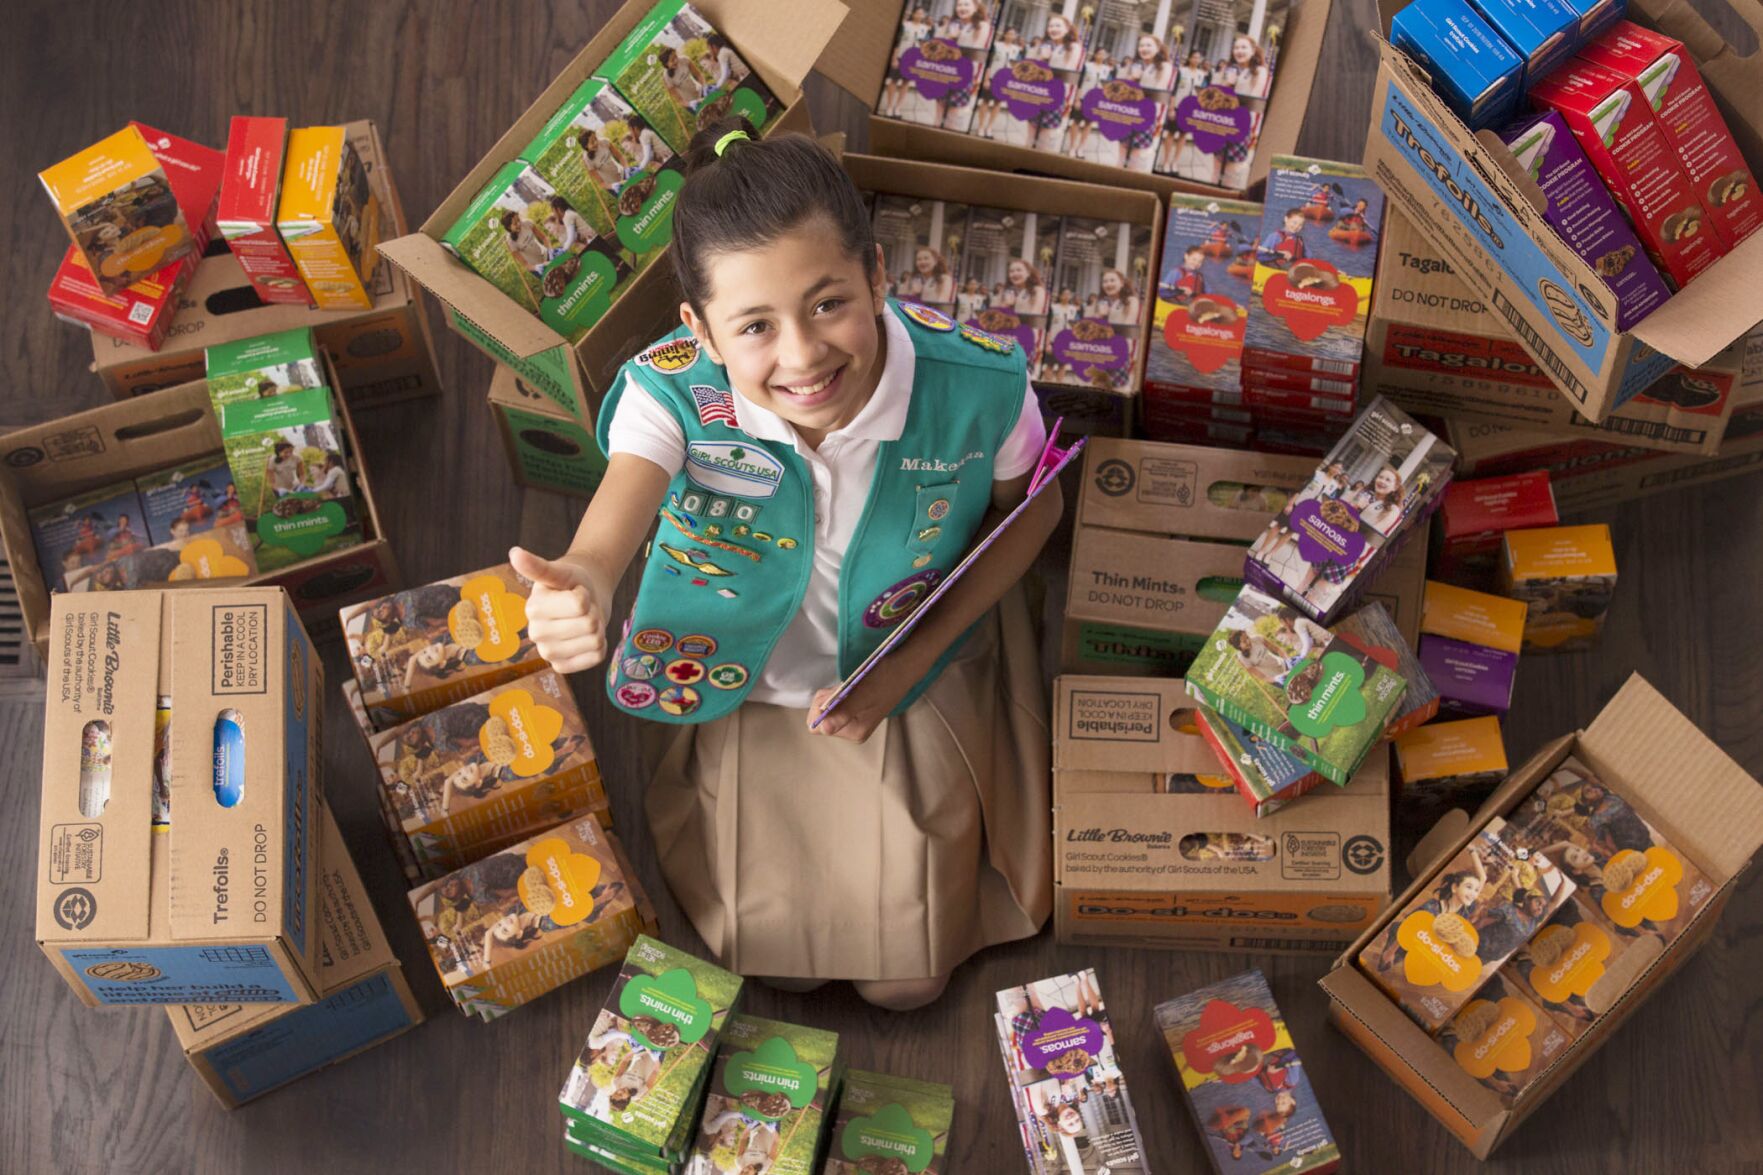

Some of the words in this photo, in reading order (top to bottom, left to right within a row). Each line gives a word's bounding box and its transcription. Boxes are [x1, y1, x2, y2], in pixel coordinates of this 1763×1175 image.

[1558, 157, 1583, 180] PROGRAM
[633, 213, 652, 236] thin
[557, 295, 577, 316] thin
[1392, 289, 1411, 302] DO
[1412, 291, 1448, 309] NOT
[691, 448, 710, 463] GIRL
[714, 457, 755, 473] SCOUTS
[757, 466, 778, 478] USA
[273, 520, 296, 533] thin
[1092, 571, 1129, 590] Thin
[1088, 590, 1109, 605] DO
[1111, 592, 1143, 609] NOT
[1144, 594, 1185, 612] DROP
[64, 613, 74, 628] Girl
[76, 613, 86, 637] baked
[88, 612, 98, 627] Girl
[237, 613, 246, 641] COOL
[87, 627, 98, 651] Scout
[105, 611, 121, 650] Little
[249, 611, 258, 665] LOCATION
[63, 629, 73, 657] Scouts
[74, 638, 84, 649] by
[221, 612, 234, 688] Perishable
[237, 642, 245, 650] A
[63, 658, 73, 667] of
[75, 650, 84, 664] the
[236, 651, 246, 661] IN
[63, 668, 72, 682] the
[73, 664, 83, 703] authority
[103, 651, 119, 715] Brownie
[236, 662, 246, 687] KEEP
[249, 666, 258, 687] DRY
[73, 704, 82, 713] of
[1077, 698, 1131, 710] LOCATION
[1133, 699, 1153, 710] DRY
[1308, 697, 1324, 720] thin
[1077, 709, 1107, 720] COOL
[1128, 710, 1153, 721] KEEP
[1077, 720, 1153, 734] Perishable
[254, 824, 267, 864] DROP
[1067, 828, 1106, 842] Little
[1107, 829, 1172, 843] Brownie
[1065, 853, 1080, 861] Girl
[1081, 853, 1105, 861] Scout
[1066, 864, 1091, 872] baked
[1092, 864, 1102, 874] by
[1104, 864, 1119, 873] the
[1119, 865, 1156, 874] authority
[1156, 865, 1166, 873] of
[1167, 865, 1182, 873] Girl
[1183, 866, 1212, 874] Scouts
[254, 866, 267, 898] NOT
[254, 900, 266, 922] DO
[669, 1008, 693, 1025] thin
[779, 1077, 799, 1090] thin
[895, 1143, 915, 1156] thin
